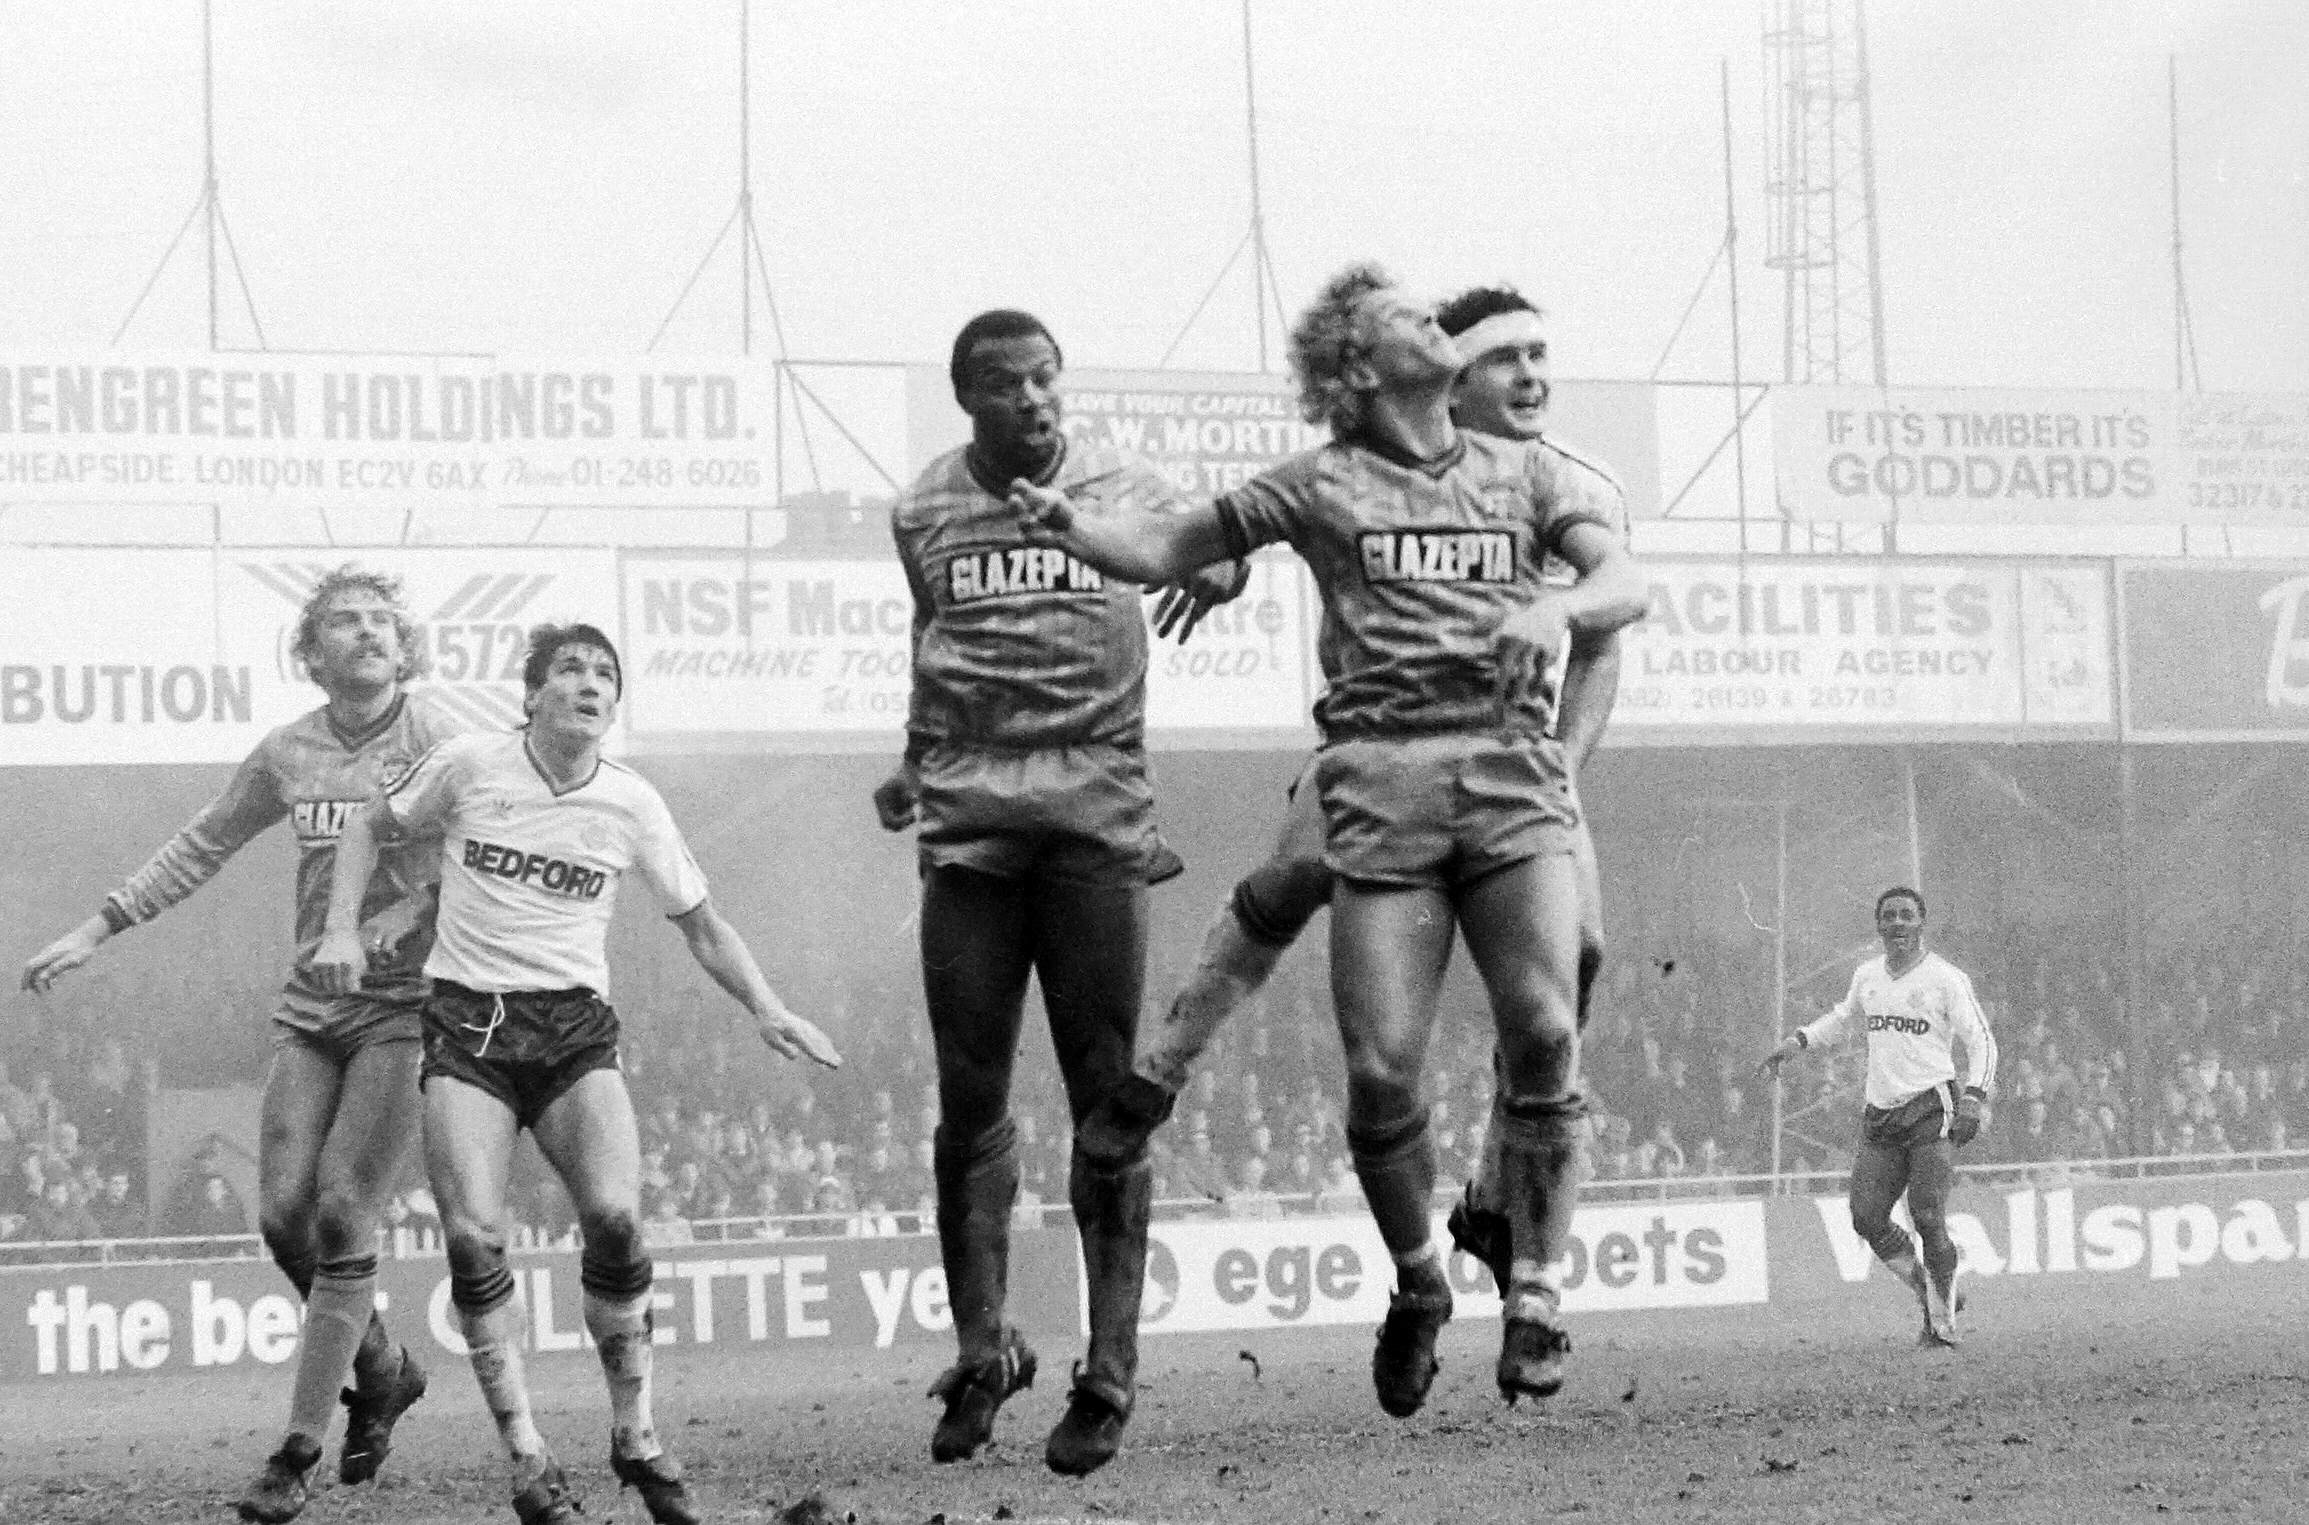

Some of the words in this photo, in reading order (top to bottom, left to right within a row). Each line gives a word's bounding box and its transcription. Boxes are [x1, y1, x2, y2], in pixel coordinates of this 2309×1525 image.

[322, 372, 614, 442] HOLDINGS
[639, 374, 758, 441] LTD.
[1191, 395, 1287, 416] CAPITAL
[1826, 410, 1854, 445] IF
[1936, 412, 2082, 448] TIMBER
[196, 455, 325, 489] LONDON
[337, 458, 416, 490] EC2V
[426, 461, 488, 491] 6AX
[687, 458, 761, 489] 6026
[1825, 451, 2156, 500] GODDARDS
[1361, 532, 1513, 582] GLAZEPTA
[643, 579, 771, 638] NSF
[786, 580, 908, 638] Mac
[1631, 582, 1993, 637] ACILITIES
[644, 648, 823, 678] MACHINE
[1163, 648, 1260, 679] SOLD
[1642, 648, 1802, 677] LABOUR
[1834, 648, 1993, 677] AGENCY
[1, 664, 252, 724] BUTION
[462, 837, 607, 900] BEDFORD
[1813, 1187, 2309, 1283] Wallspa
[1212, 1242, 1364, 1322] ege
[27, 1285, 172, 1374] the
[426, 1254, 831, 1356] LETTE
